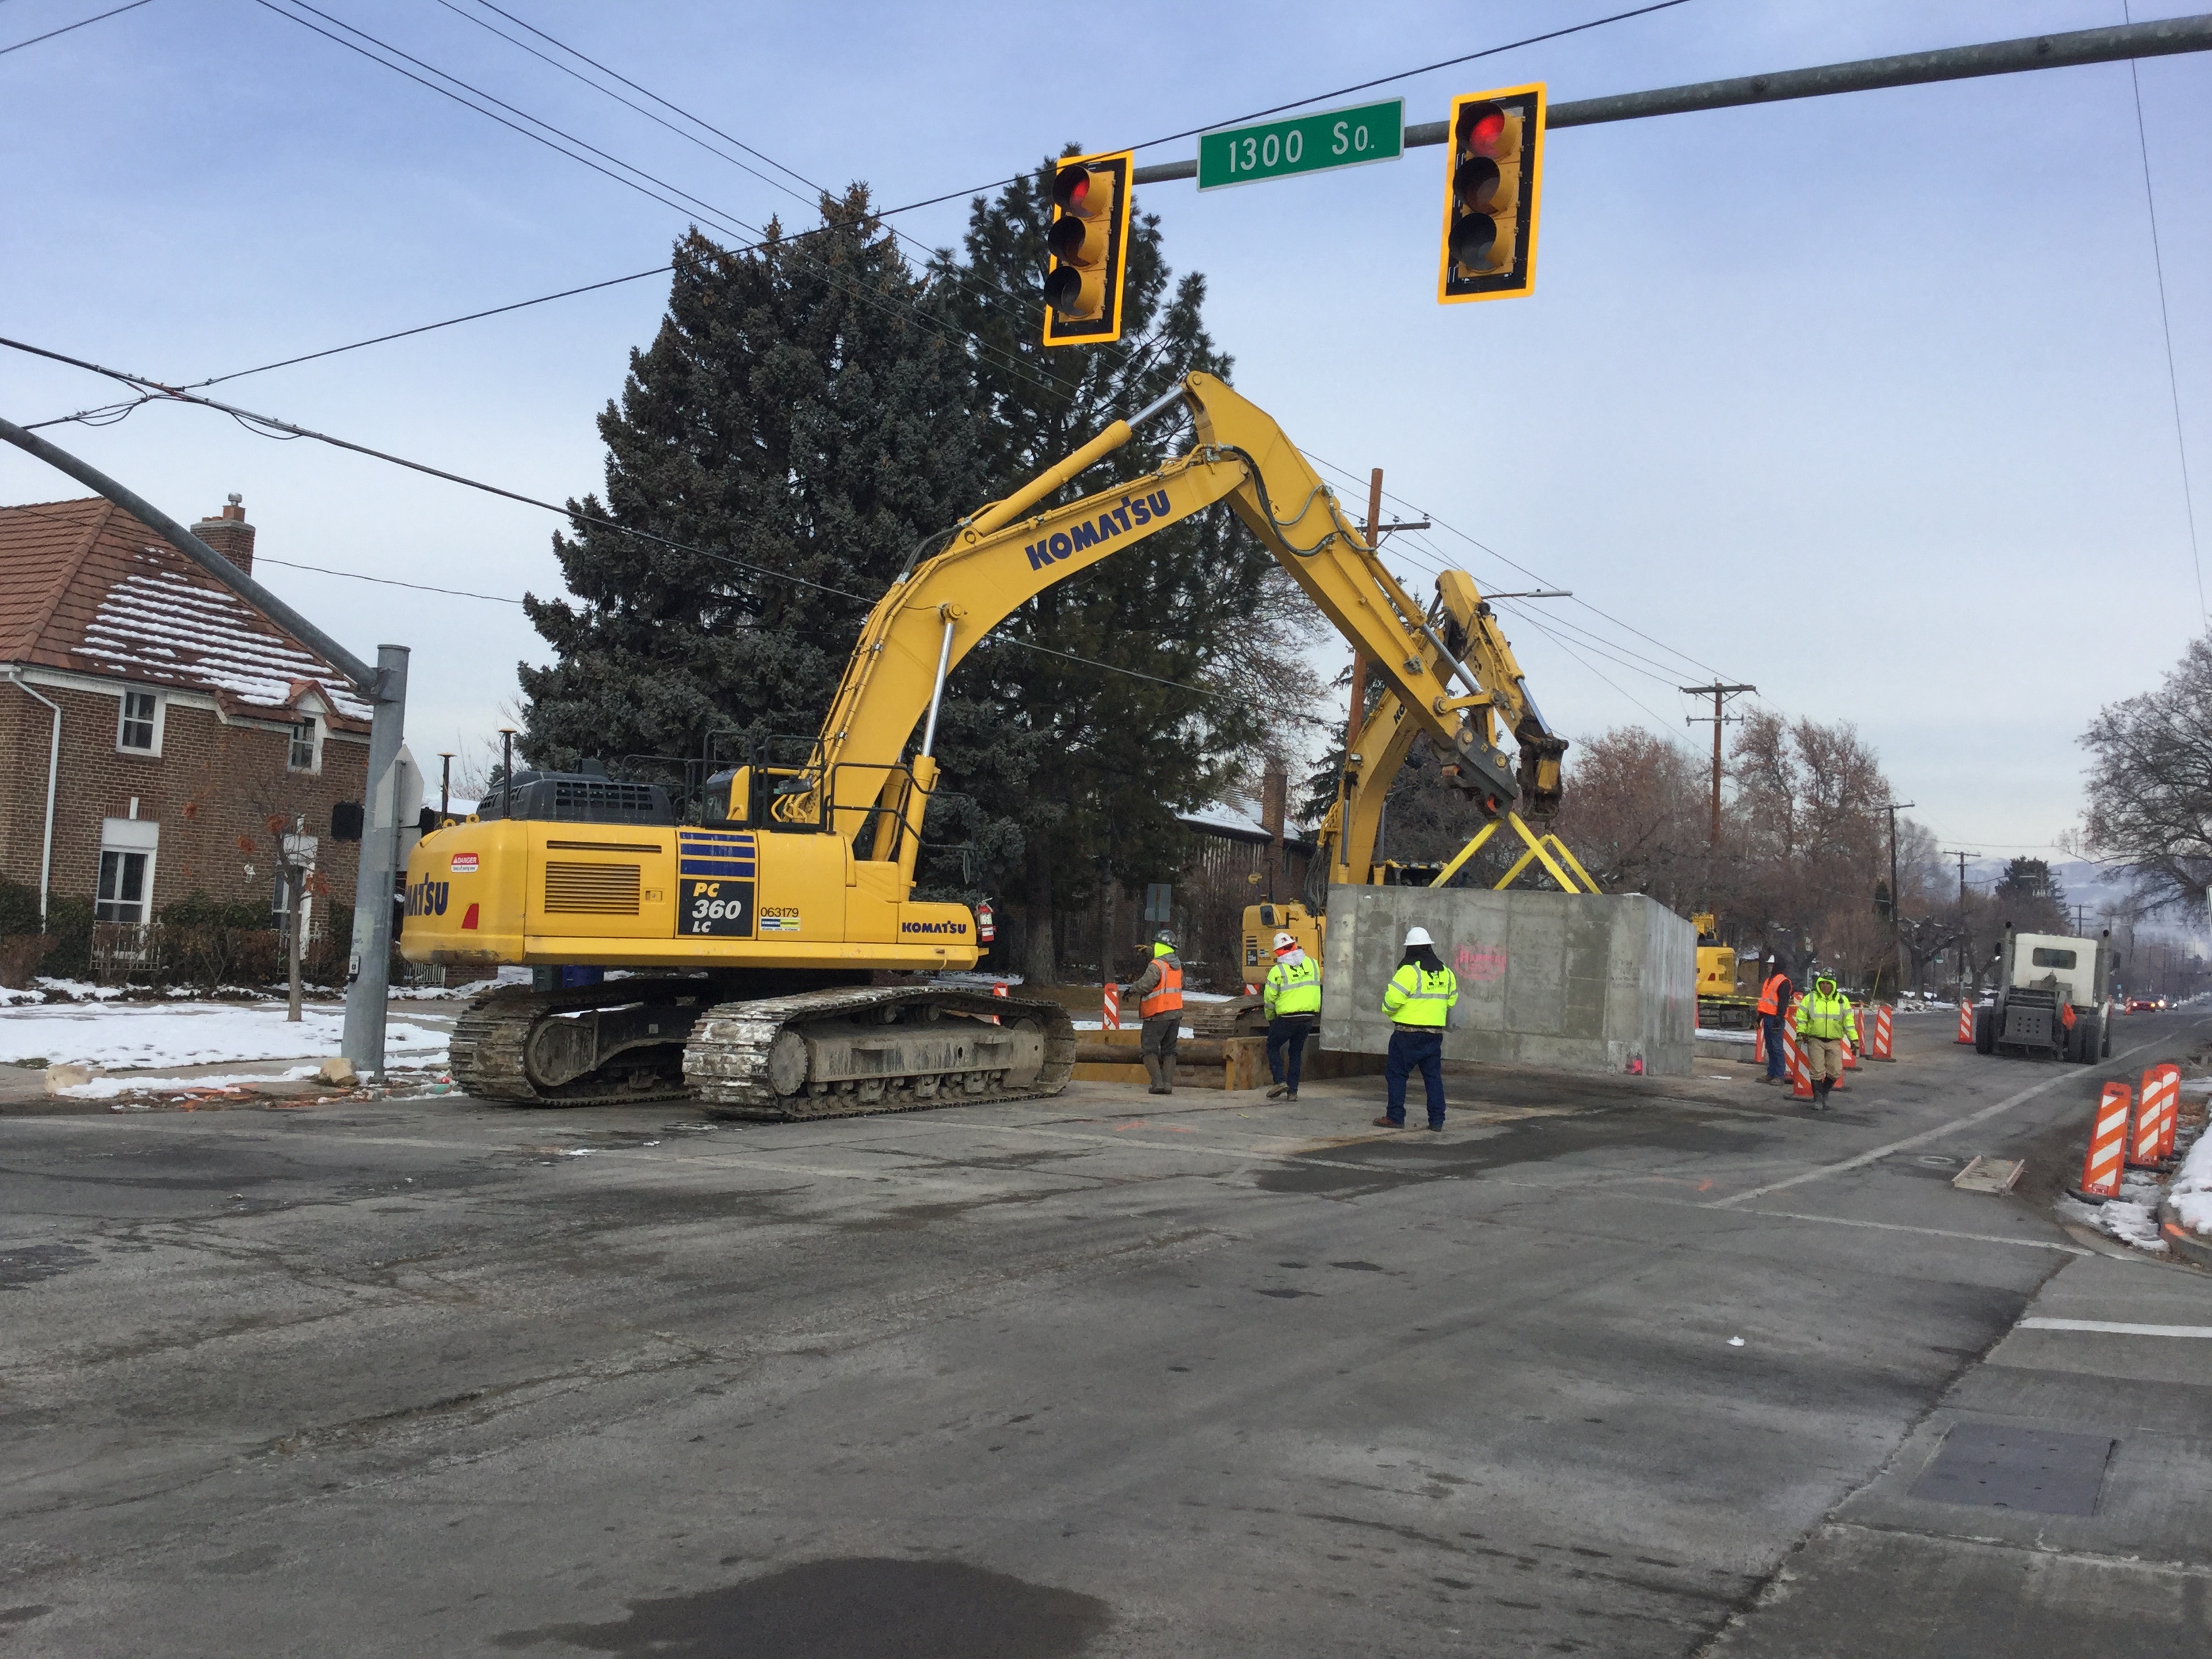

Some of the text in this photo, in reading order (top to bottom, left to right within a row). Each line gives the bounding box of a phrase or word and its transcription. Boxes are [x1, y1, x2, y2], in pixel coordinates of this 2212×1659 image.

[1229, 121, 1376, 172] 1300 So.
[1024, 489, 1171, 571] KOMATSU
[693, 882, 720, 897] PC
[692, 899, 742, 920] 360
[760, 907, 799, 918] 063179
[692, 920, 712, 933] LC
[901, 920, 967, 935] KOMATSU
